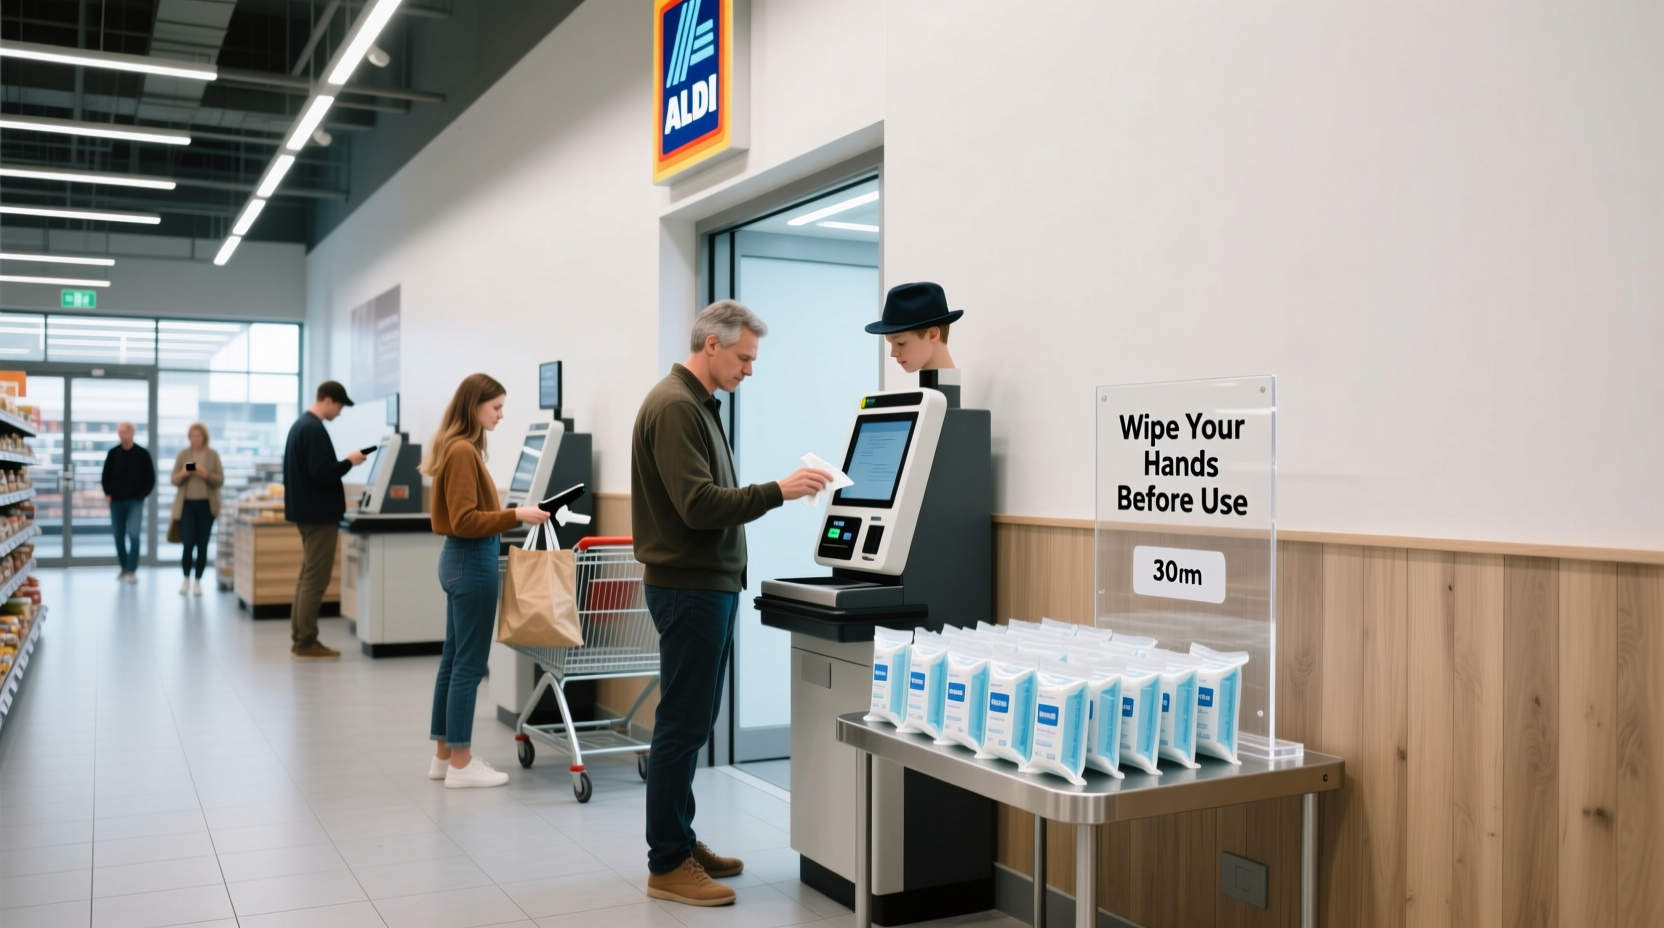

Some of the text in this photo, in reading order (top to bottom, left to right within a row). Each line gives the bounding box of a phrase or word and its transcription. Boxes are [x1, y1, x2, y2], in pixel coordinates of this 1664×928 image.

[664, 73, 717, 135] ALDI
[1119, 412, 1245, 447] Wipe Your
[1144, 449, 1219, 477] Hands
[1117, 484, 1248, 516] Before Use
